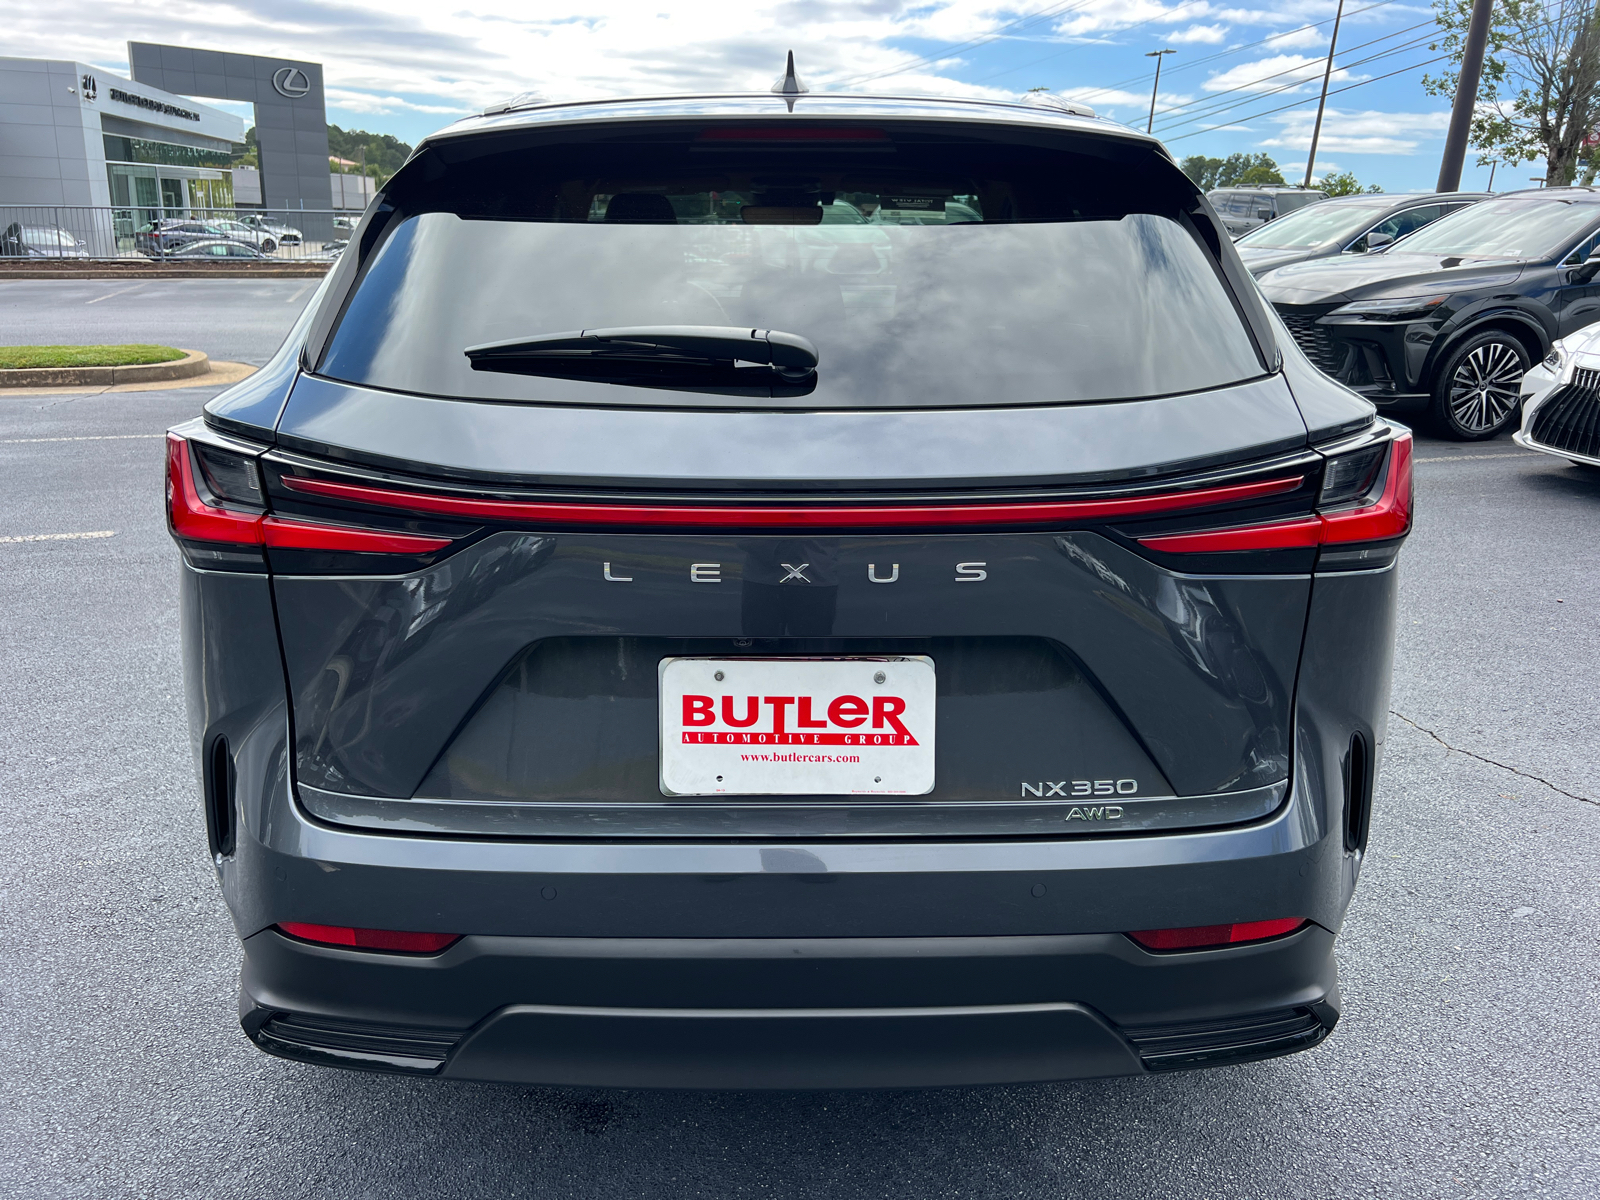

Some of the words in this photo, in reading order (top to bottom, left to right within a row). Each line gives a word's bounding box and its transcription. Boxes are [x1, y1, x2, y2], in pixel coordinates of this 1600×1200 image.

[603, 562, 988, 583] LEXUS
[683, 733, 821, 744] AUTOMOTIVE
[844, 735, 912, 745] GROUP
[740, 752, 861, 764] www.butlercars.com
[1065, 806, 1124, 821] AWD
